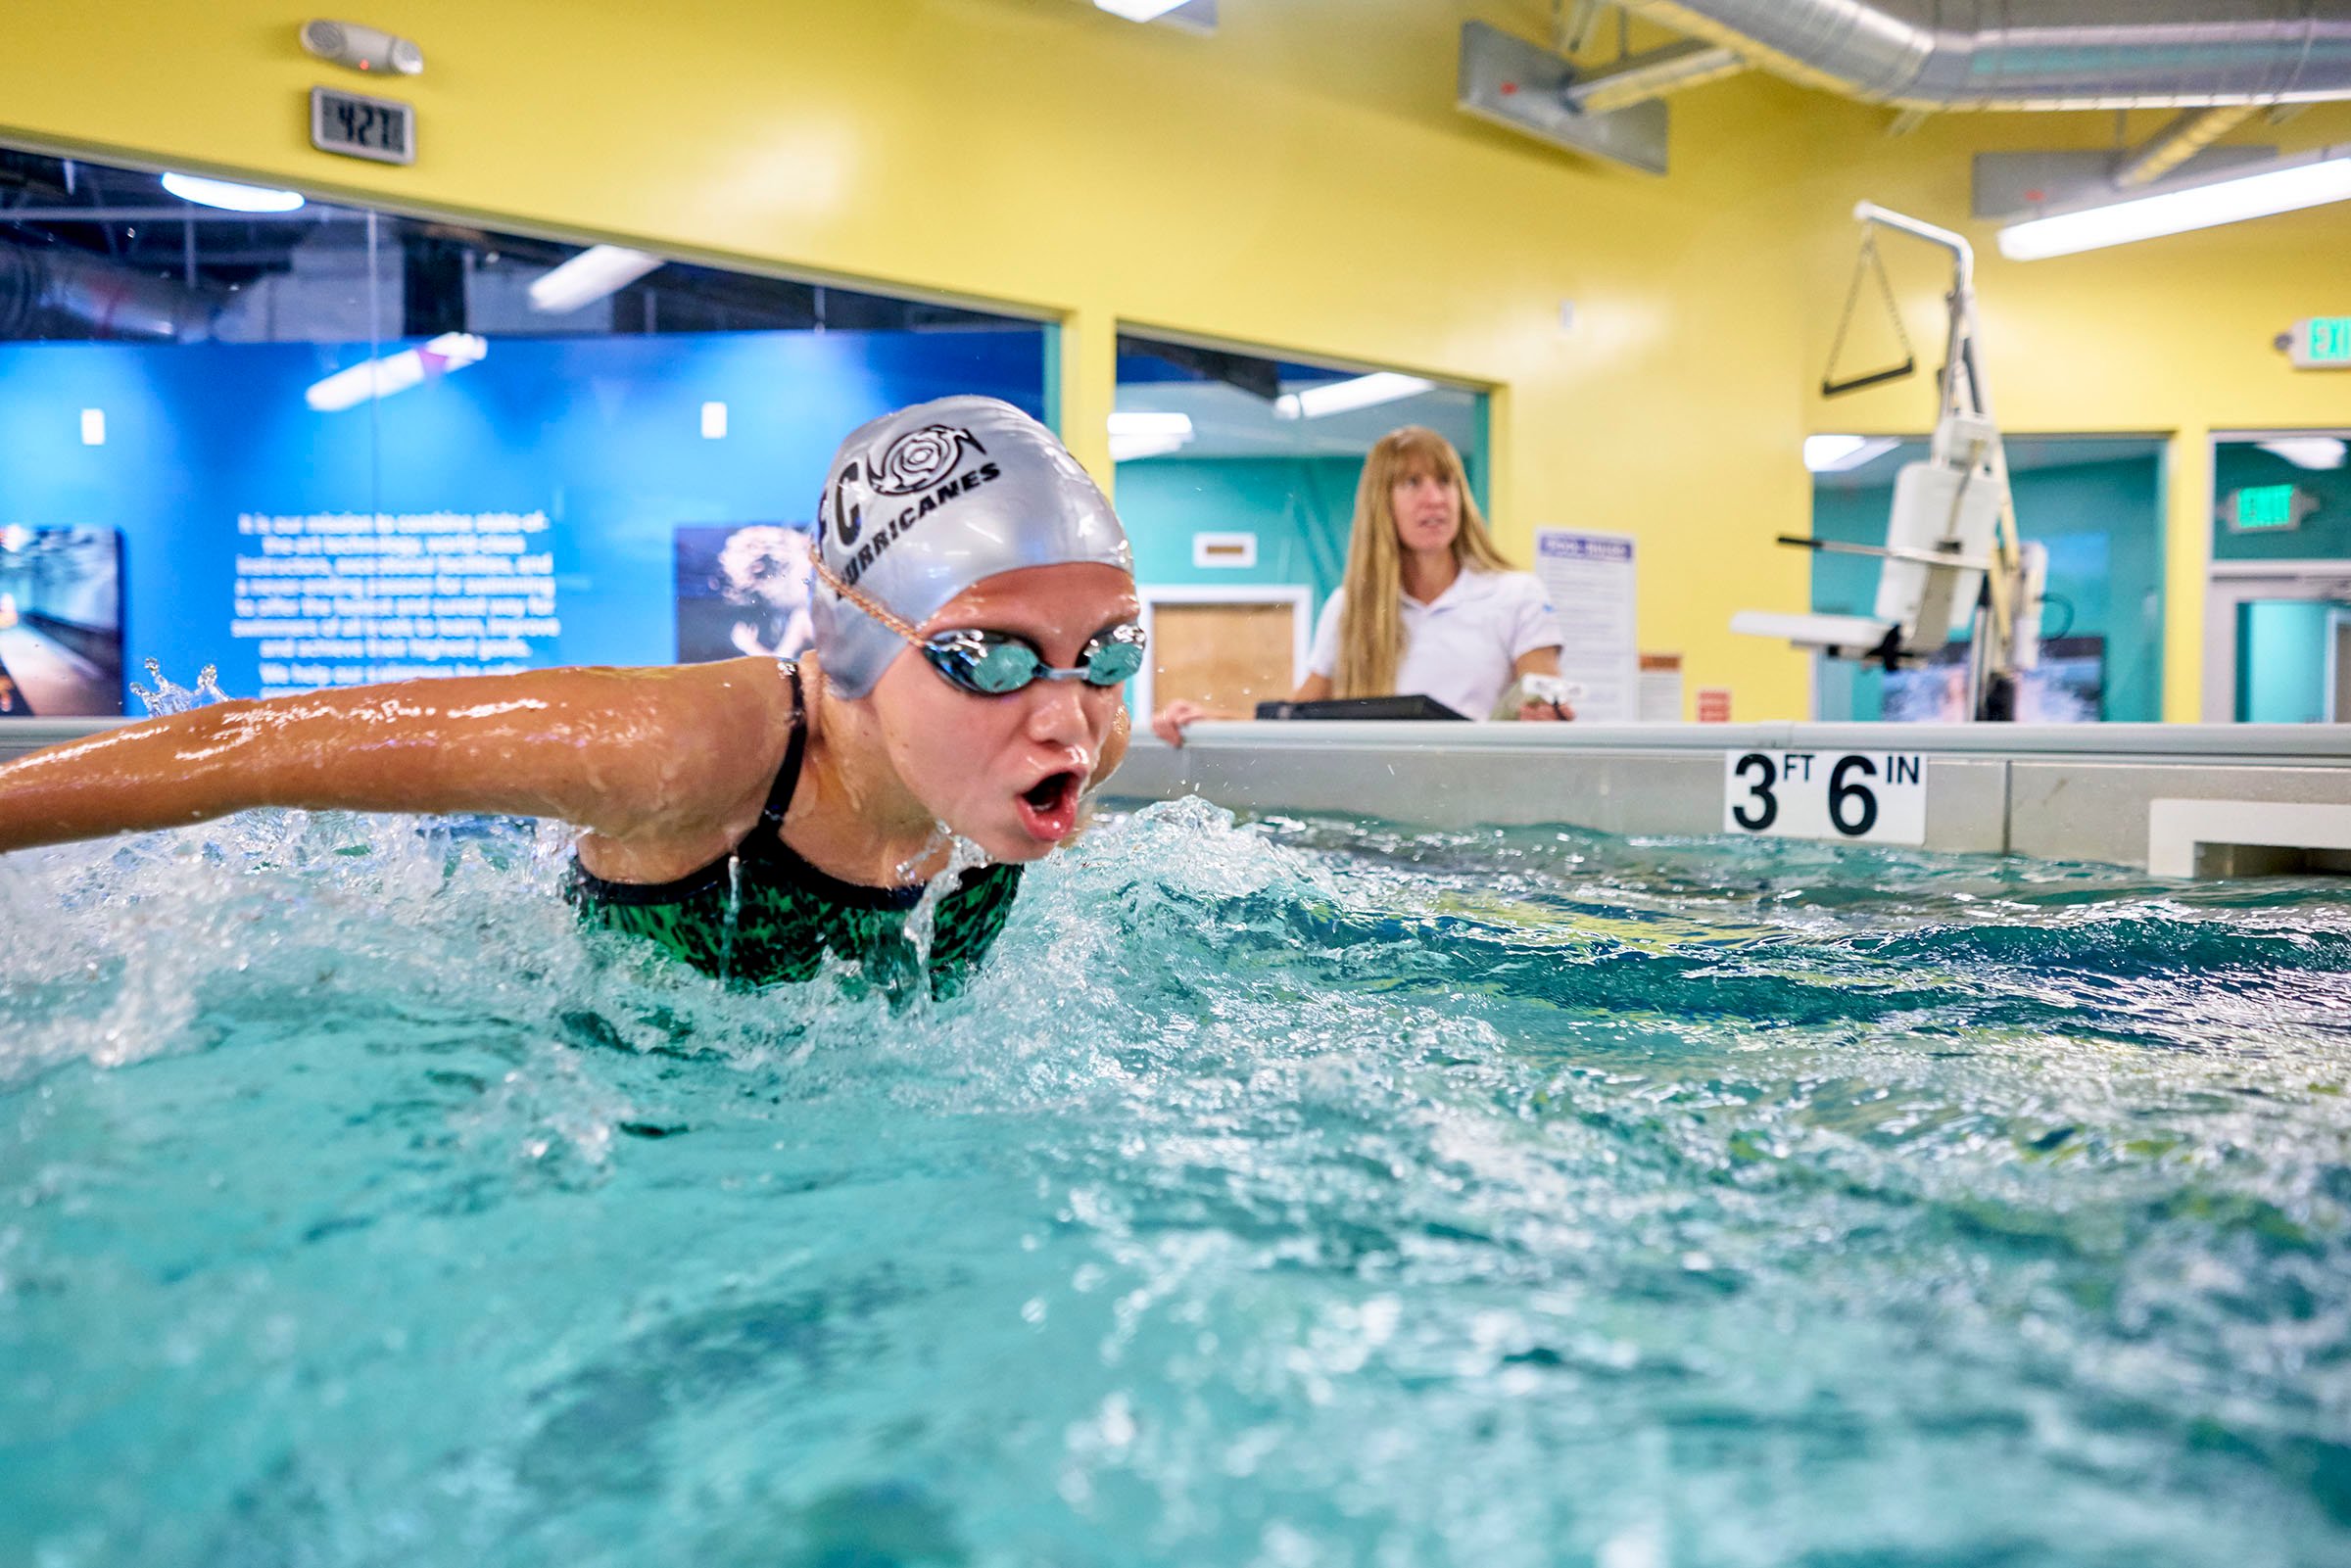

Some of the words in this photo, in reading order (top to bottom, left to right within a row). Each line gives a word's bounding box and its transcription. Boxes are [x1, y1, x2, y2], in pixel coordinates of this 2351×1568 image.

[2310, 318, 2351, 360] EXI
[1732, 753, 1778, 831] 3
[1784, 754, 1815, 782] FT
[1829, 755, 1877, 835] 6
[1887, 756, 1919, 784] IN
